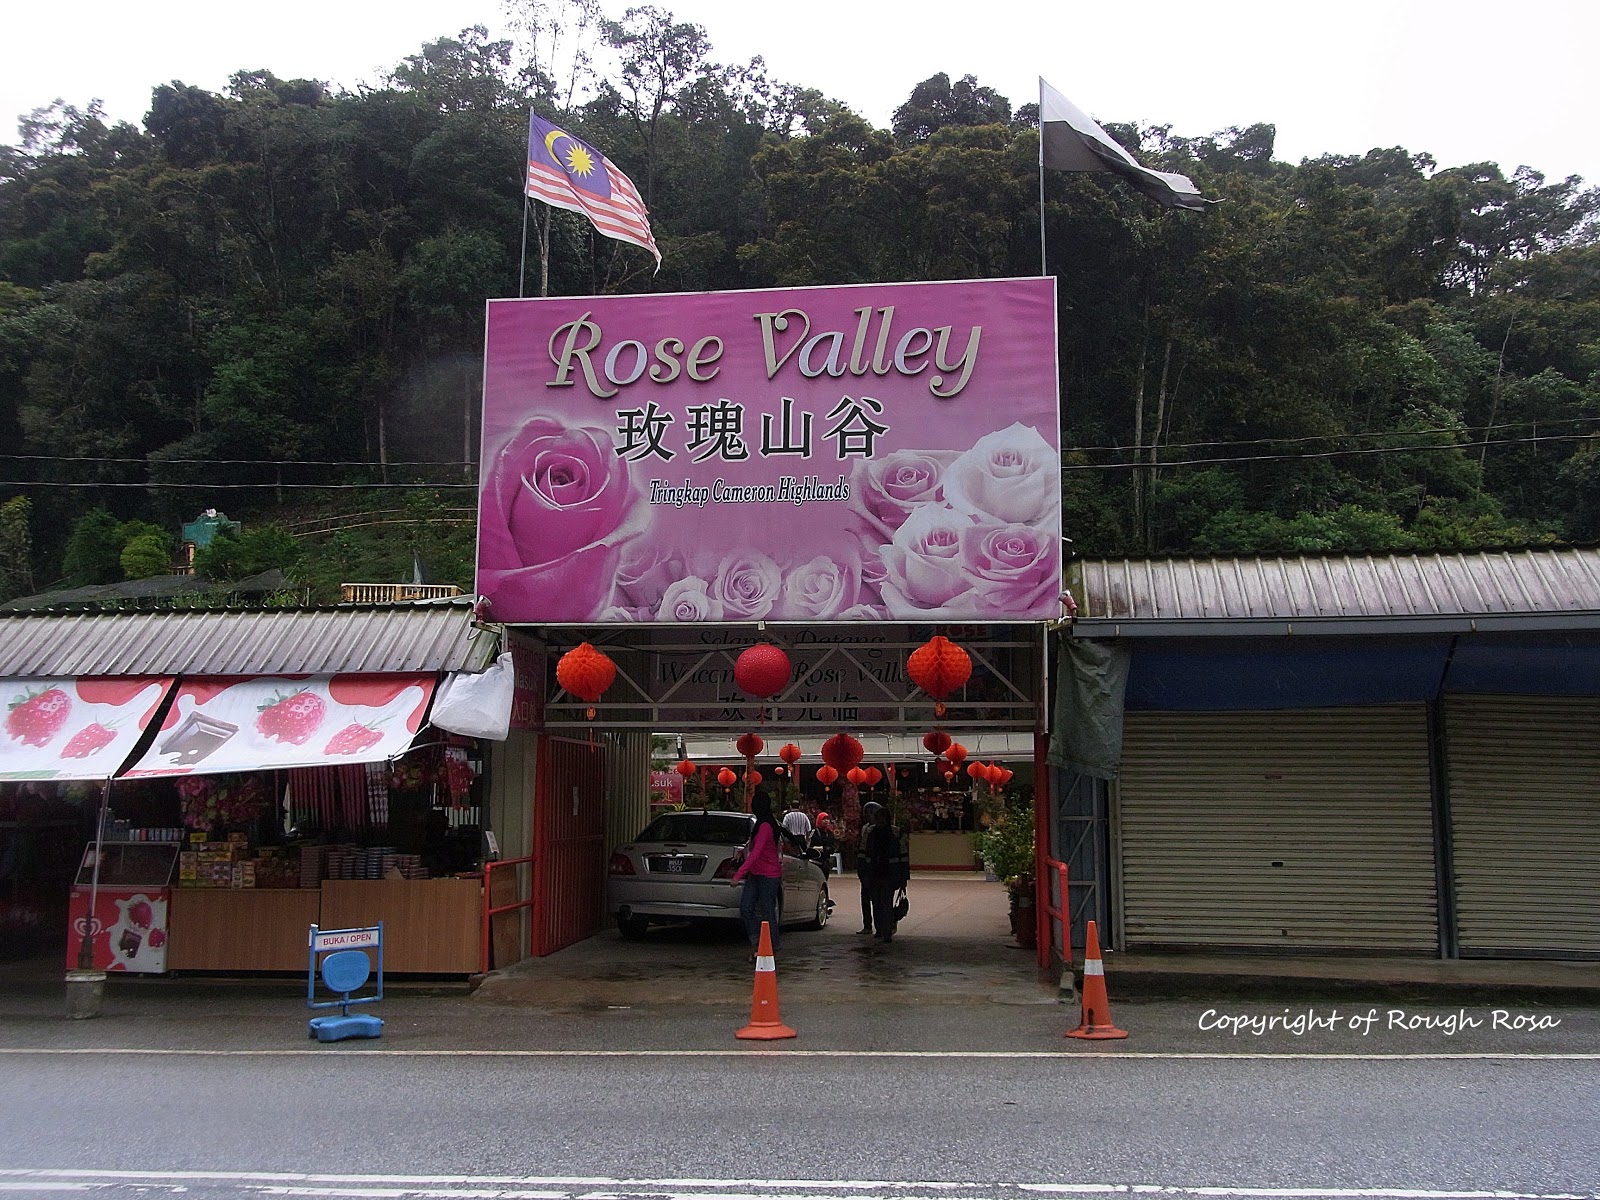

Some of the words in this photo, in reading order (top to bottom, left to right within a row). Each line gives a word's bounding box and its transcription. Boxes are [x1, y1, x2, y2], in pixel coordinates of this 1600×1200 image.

[546, 310, 724, 399] Rose
[753, 305, 983, 398] Valley
[615, 395, 890, 463] 玫瑰山谷
[649, 479, 710, 508] Tringkap
[711, 477, 776, 503] Cameron
[776, 475, 850, 507] Highlands
[660, 661, 737, 684] Welcom
[791, 660, 847, 687] Rose
[857, 661, 921, 692] Valle
[651, 777, 673, 787] suk
[323, 936, 345, 945] BUKA
[350, 933, 371, 942] OPEN
